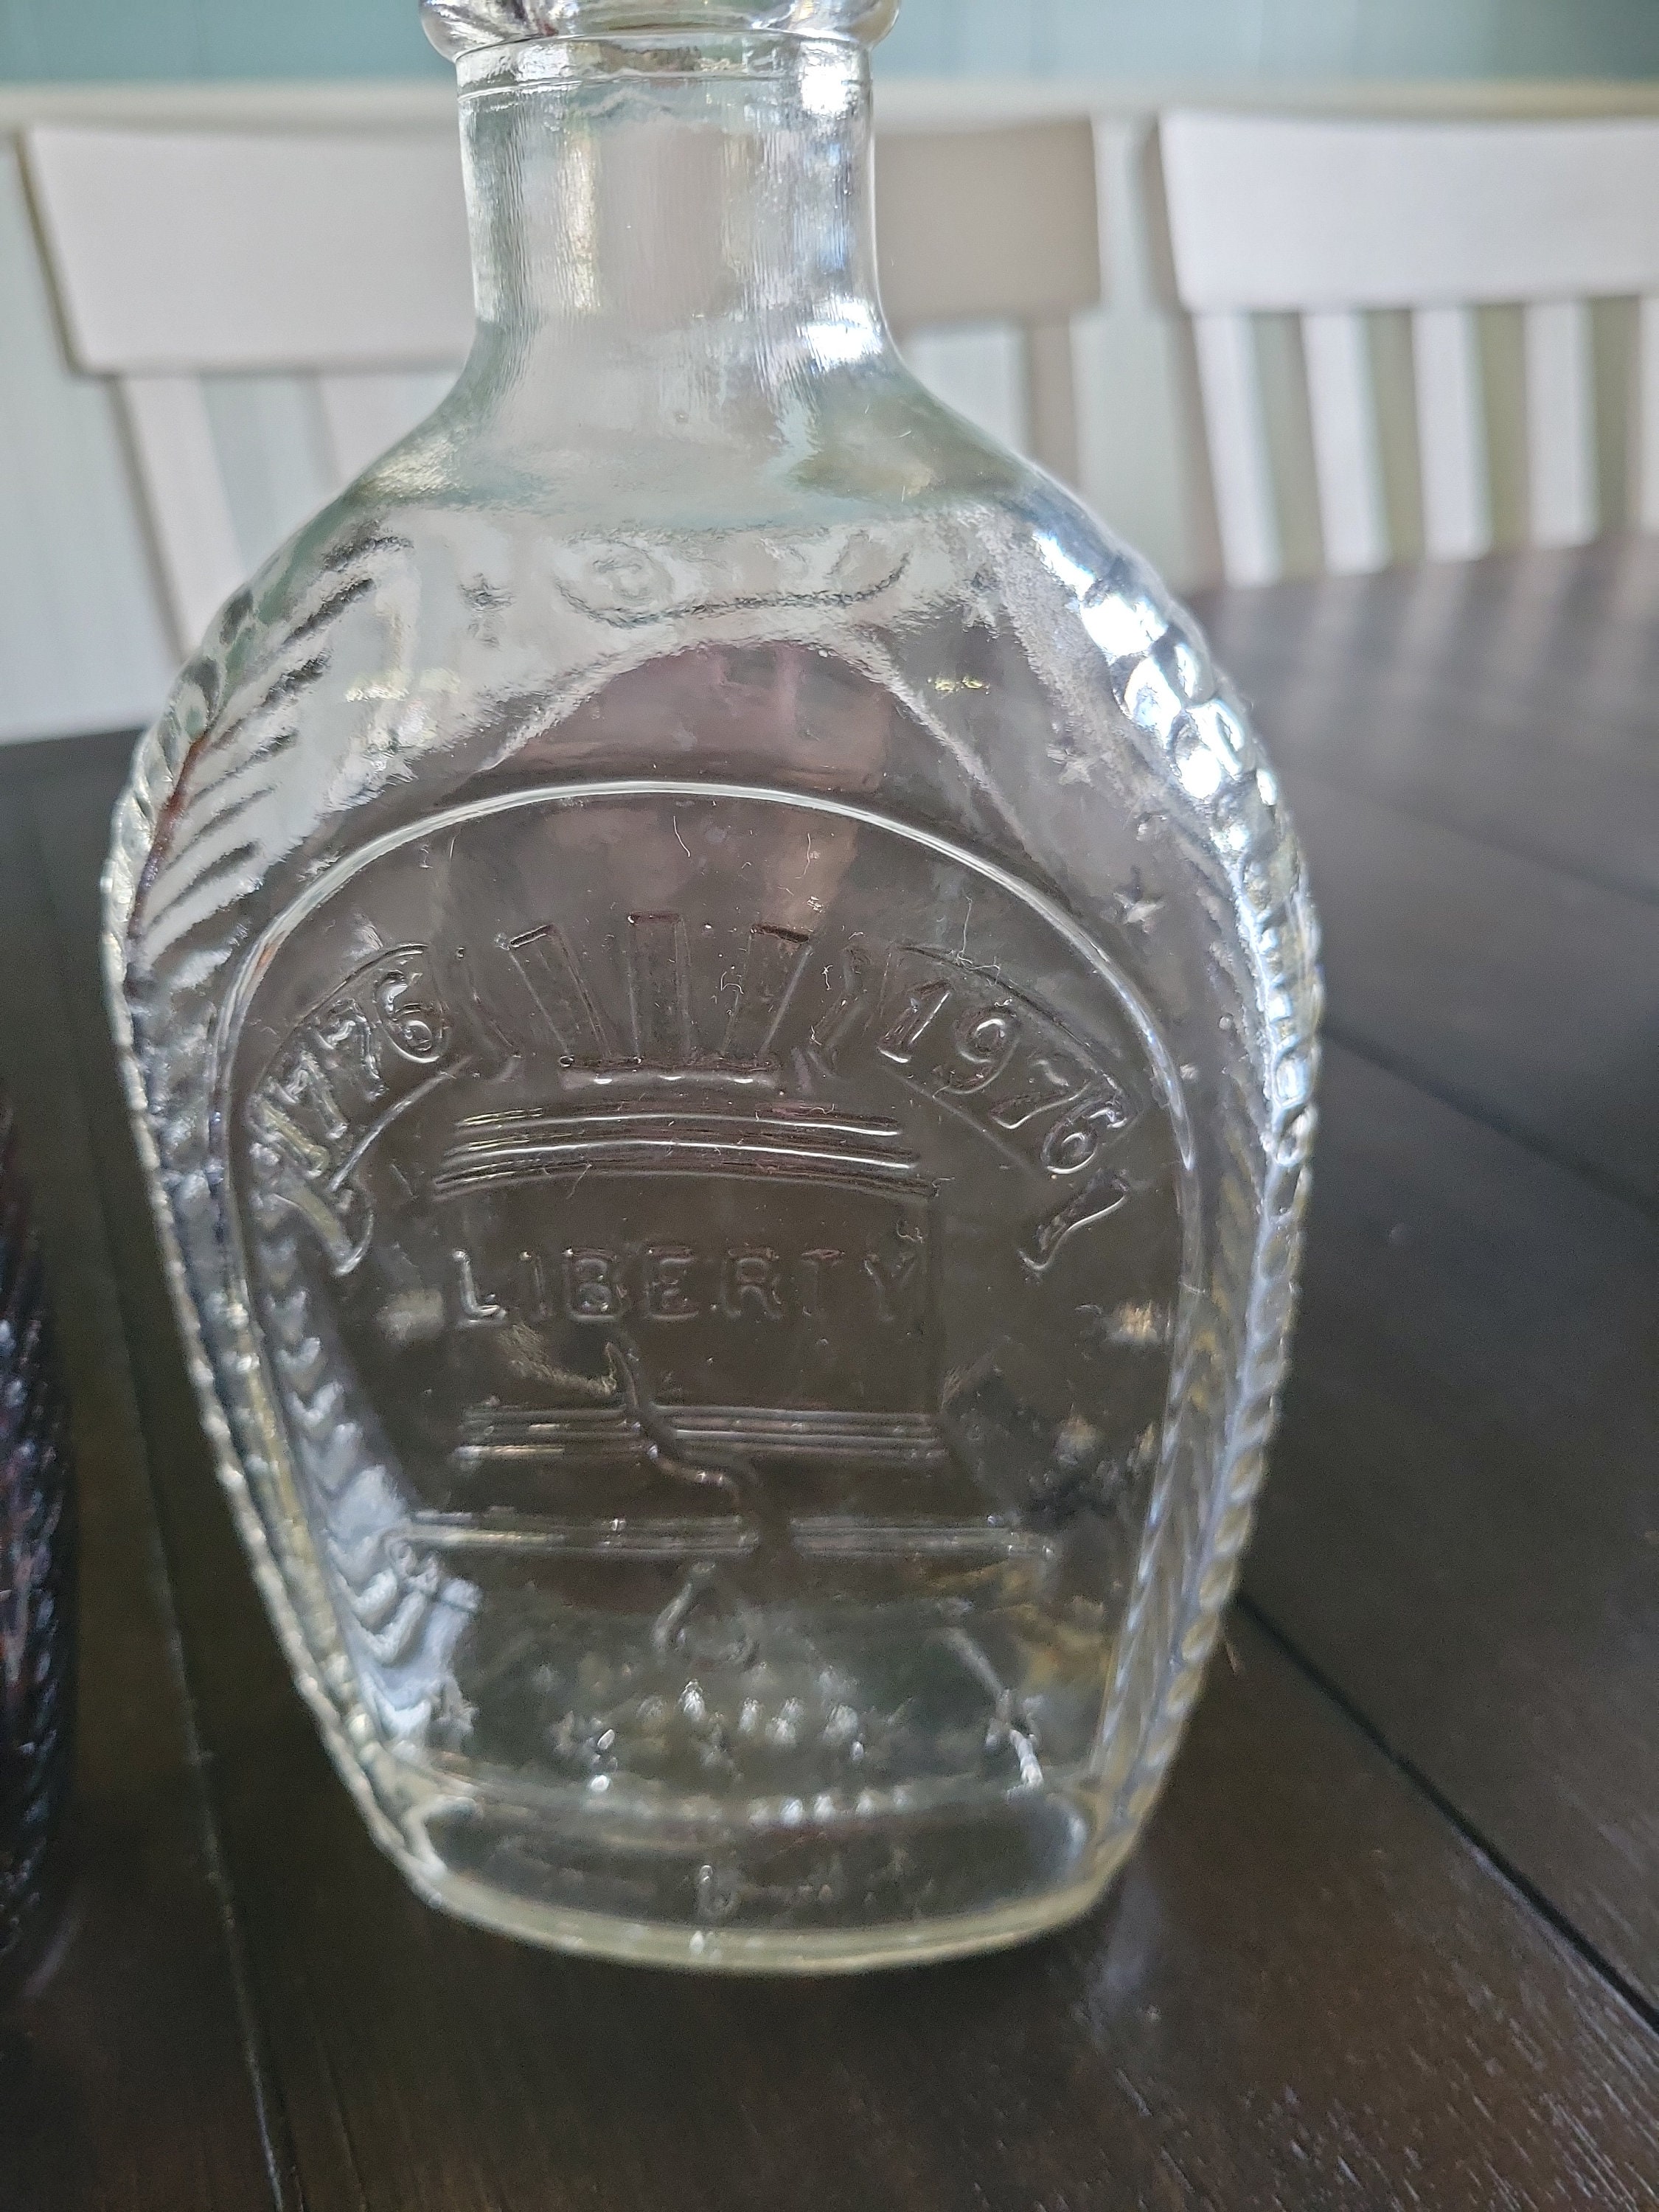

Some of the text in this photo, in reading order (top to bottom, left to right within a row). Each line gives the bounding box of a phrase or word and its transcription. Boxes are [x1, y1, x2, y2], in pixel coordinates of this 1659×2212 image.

[245, 964, 445, 1180] 1776
[877, 976, 1135, 1175] 1976
[451, 1242, 919, 1325] LIBERTY
